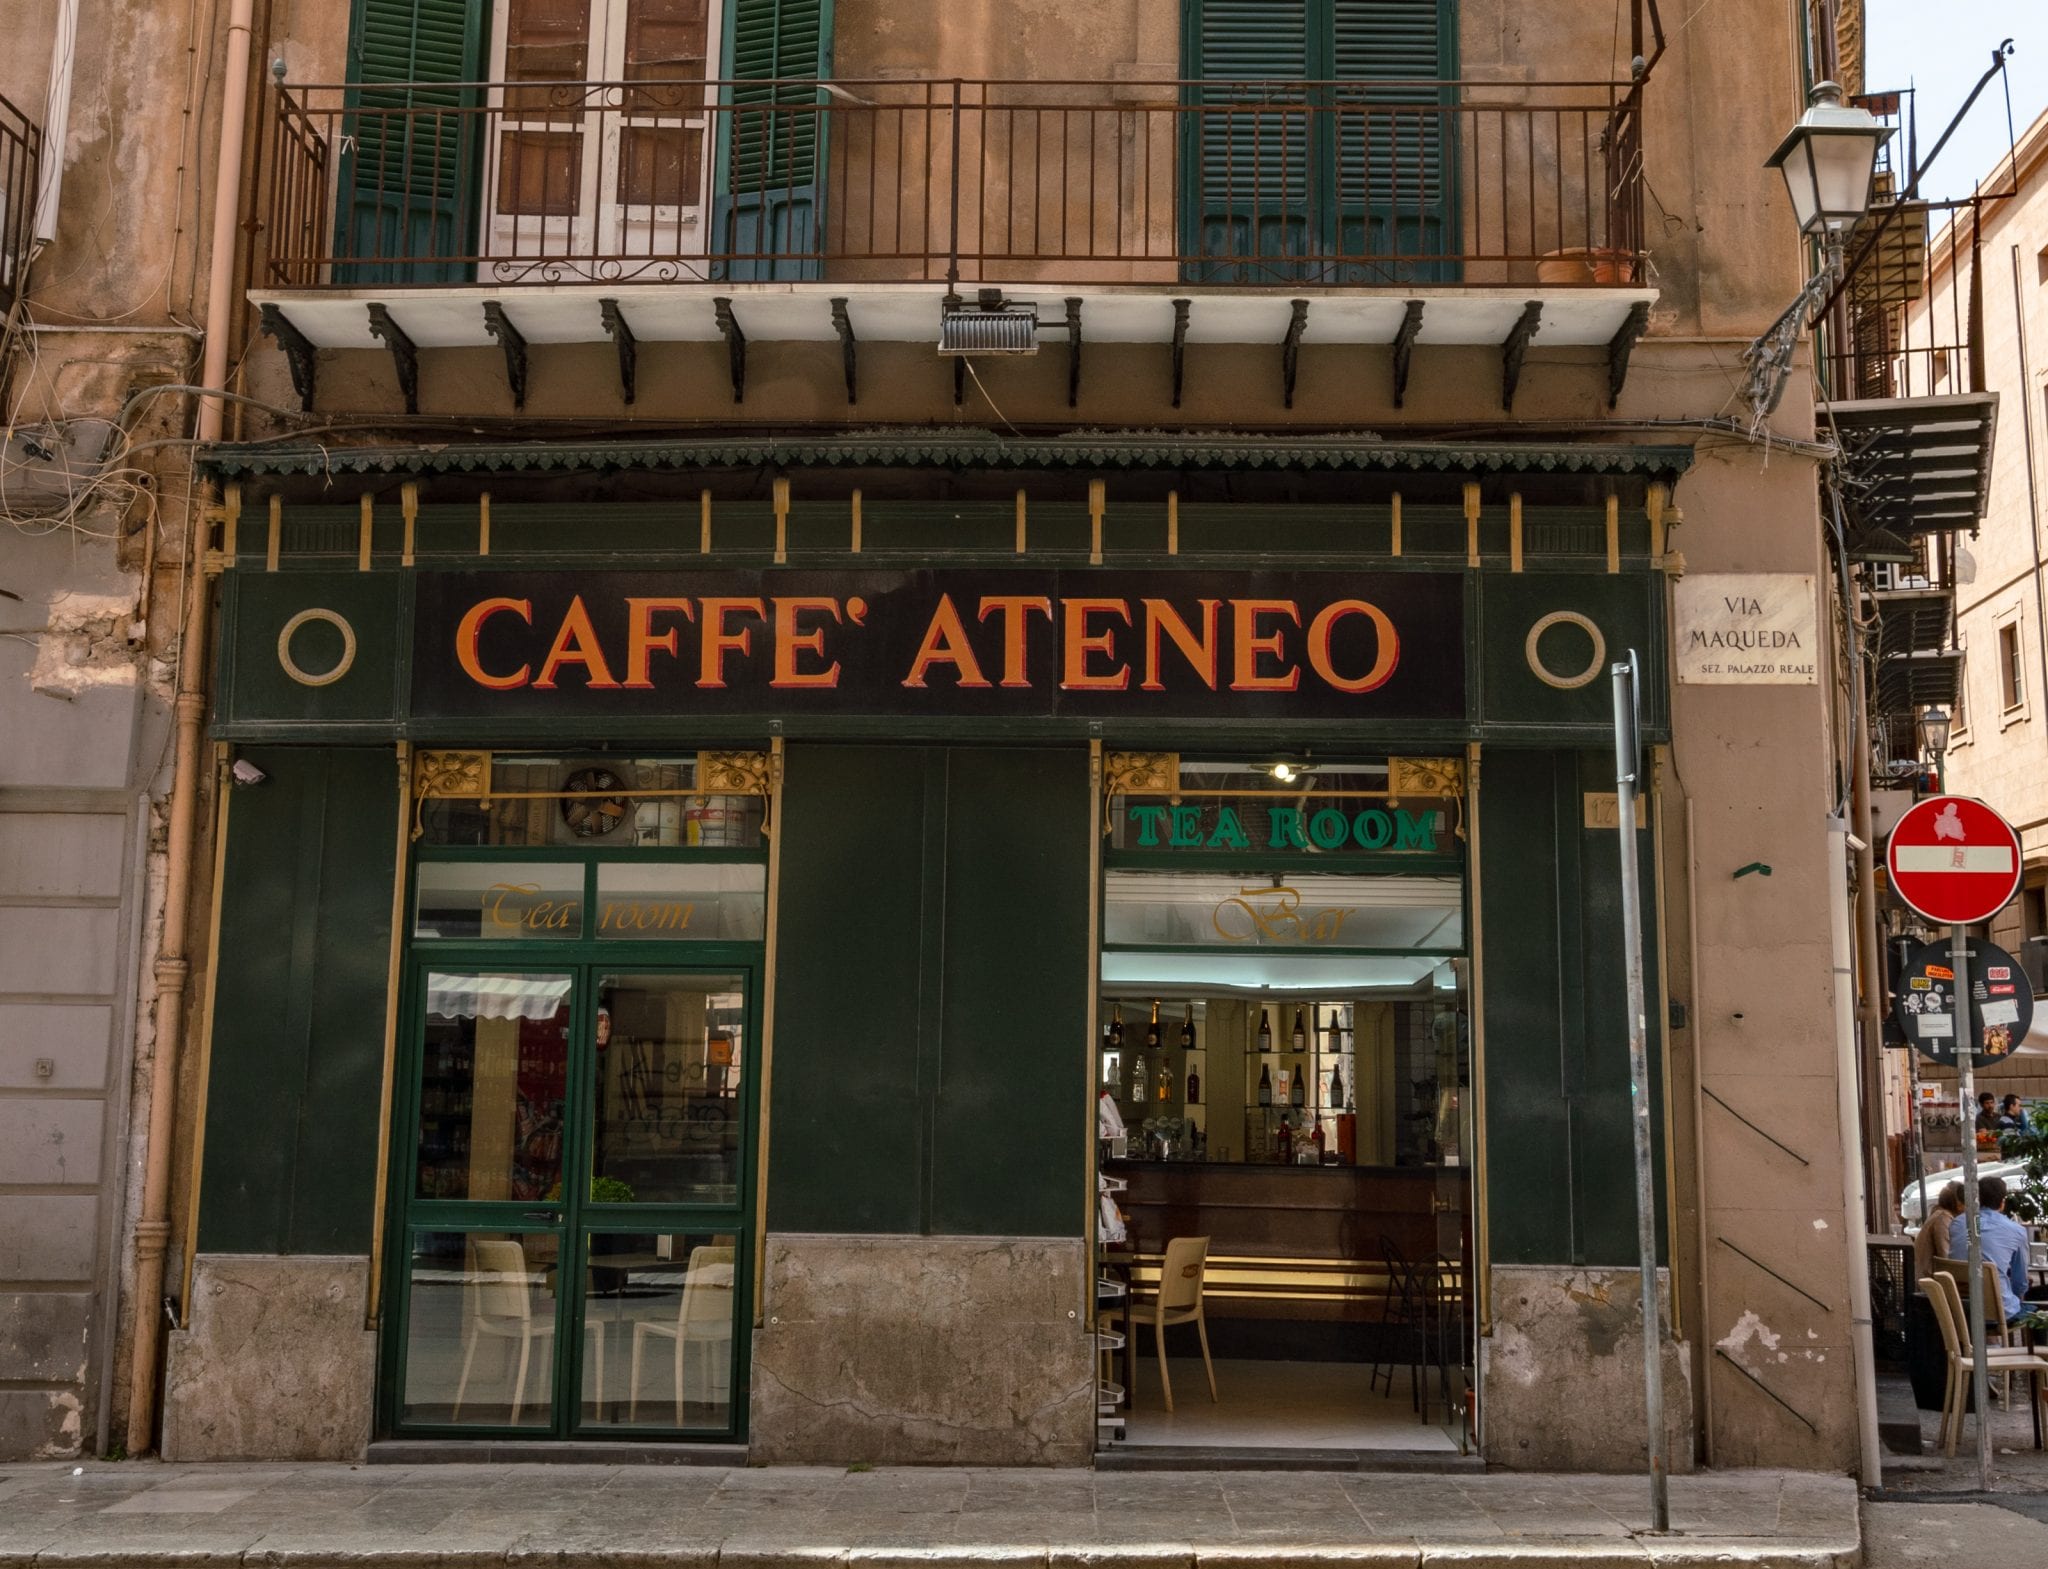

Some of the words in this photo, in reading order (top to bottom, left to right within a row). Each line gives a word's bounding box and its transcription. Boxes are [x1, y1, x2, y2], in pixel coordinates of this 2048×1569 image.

[1724, 596, 1763, 615] VIA
[901, 592, 1400, 693] ATENEO
[1690, 629, 1801, 651] MAQUEDA
[1727, 664, 1775, 674] PALAZZO
[1780, 664, 1815, 674] REALE
[1129, 805, 1250, 847] TEA
[1267, 807, 1438, 850] ROOM
[481, 882, 577, 929] Tea
[600, 902, 695, 929] room
[1213, 885, 1356, 941] Bar
